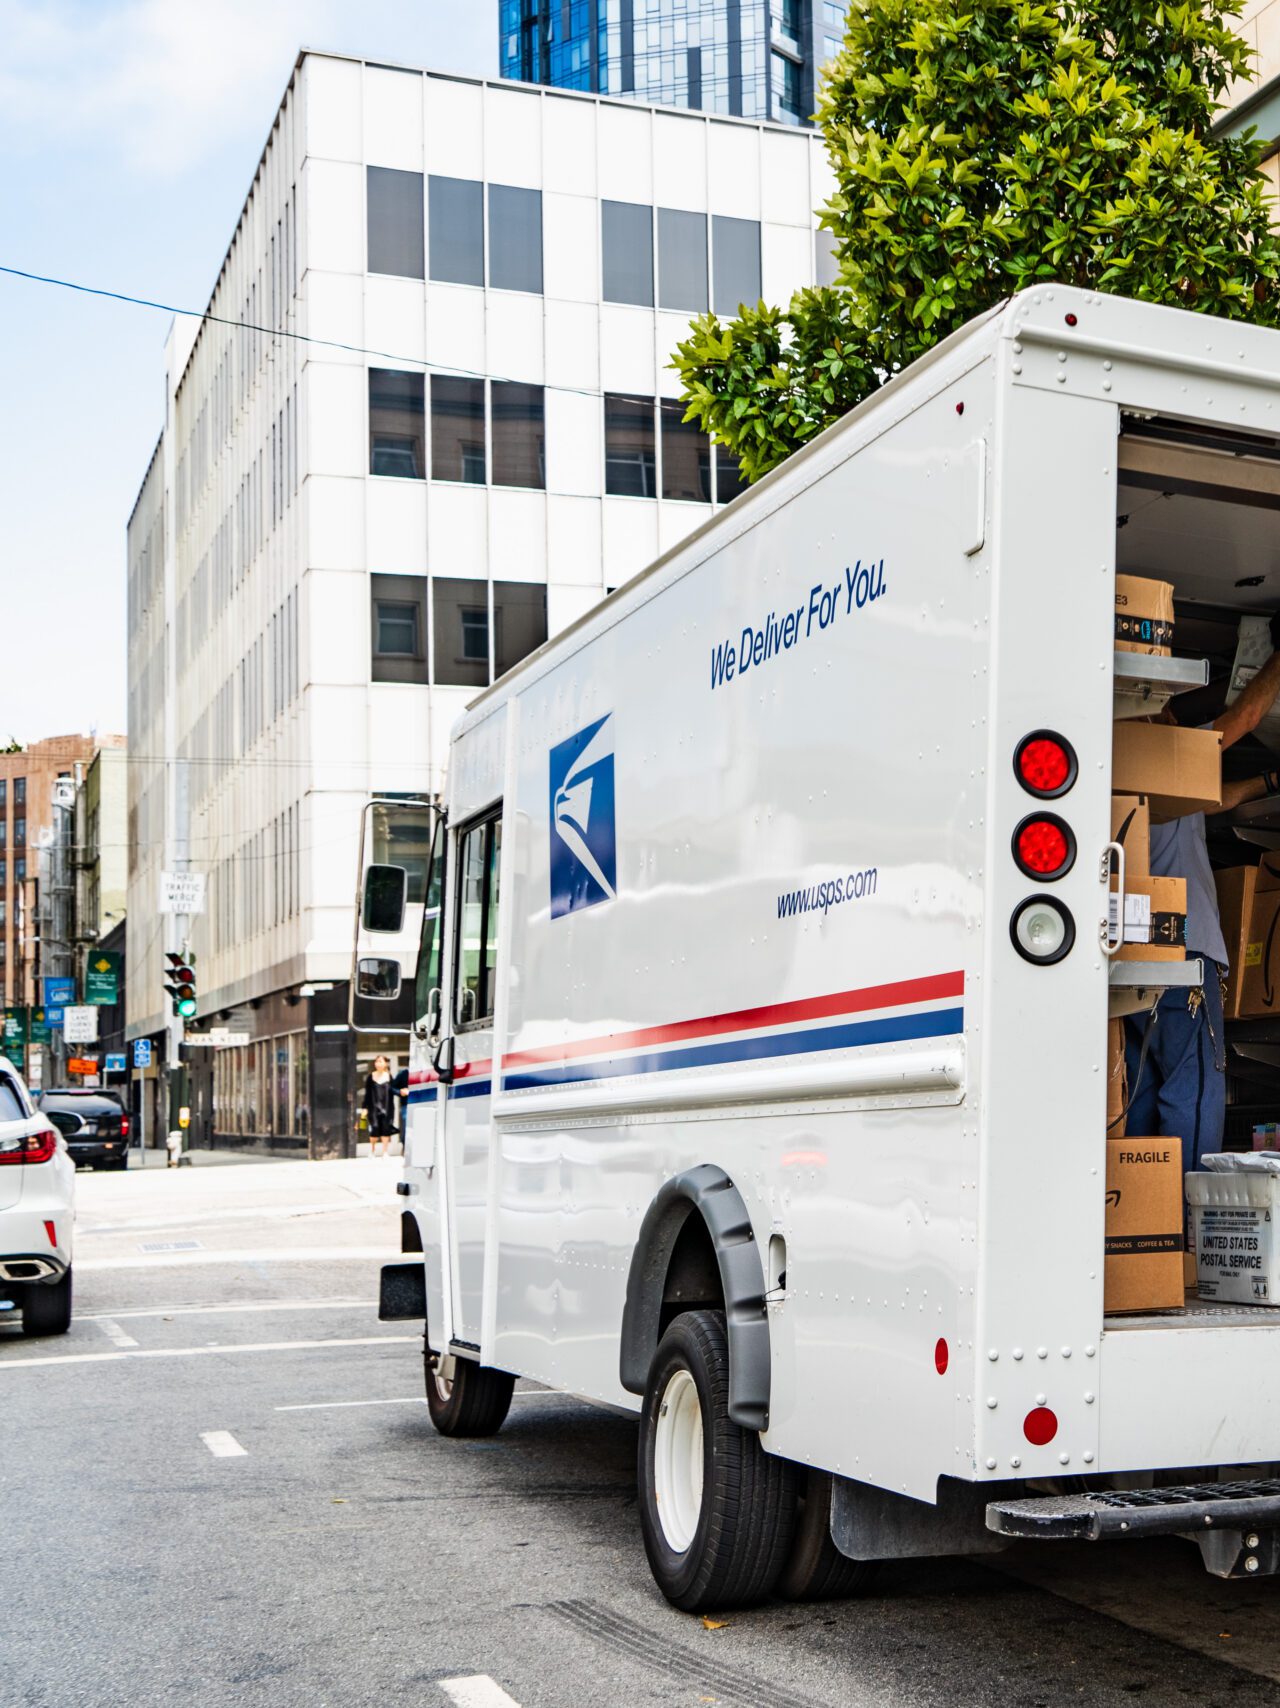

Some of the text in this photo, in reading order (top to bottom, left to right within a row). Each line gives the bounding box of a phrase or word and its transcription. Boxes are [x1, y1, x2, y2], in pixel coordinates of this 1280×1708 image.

[711, 558, 887, 690] We Deliver For You.
[166, 883, 201, 892] TRAFFIC
[777, 867, 878, 919] www.usps.com
[168, 893, 196, 902] MERGE
[171, 903, 192, 912] LEFT
[1119, 1152, 1171, 1164] FRAGILE
[1164, 1239, 1175, 1247] TEA
[1202, 1235, 1258, 1251] UNITED STATES
[1200, 1253, 1262, 1269] POSTAL SERVICE
